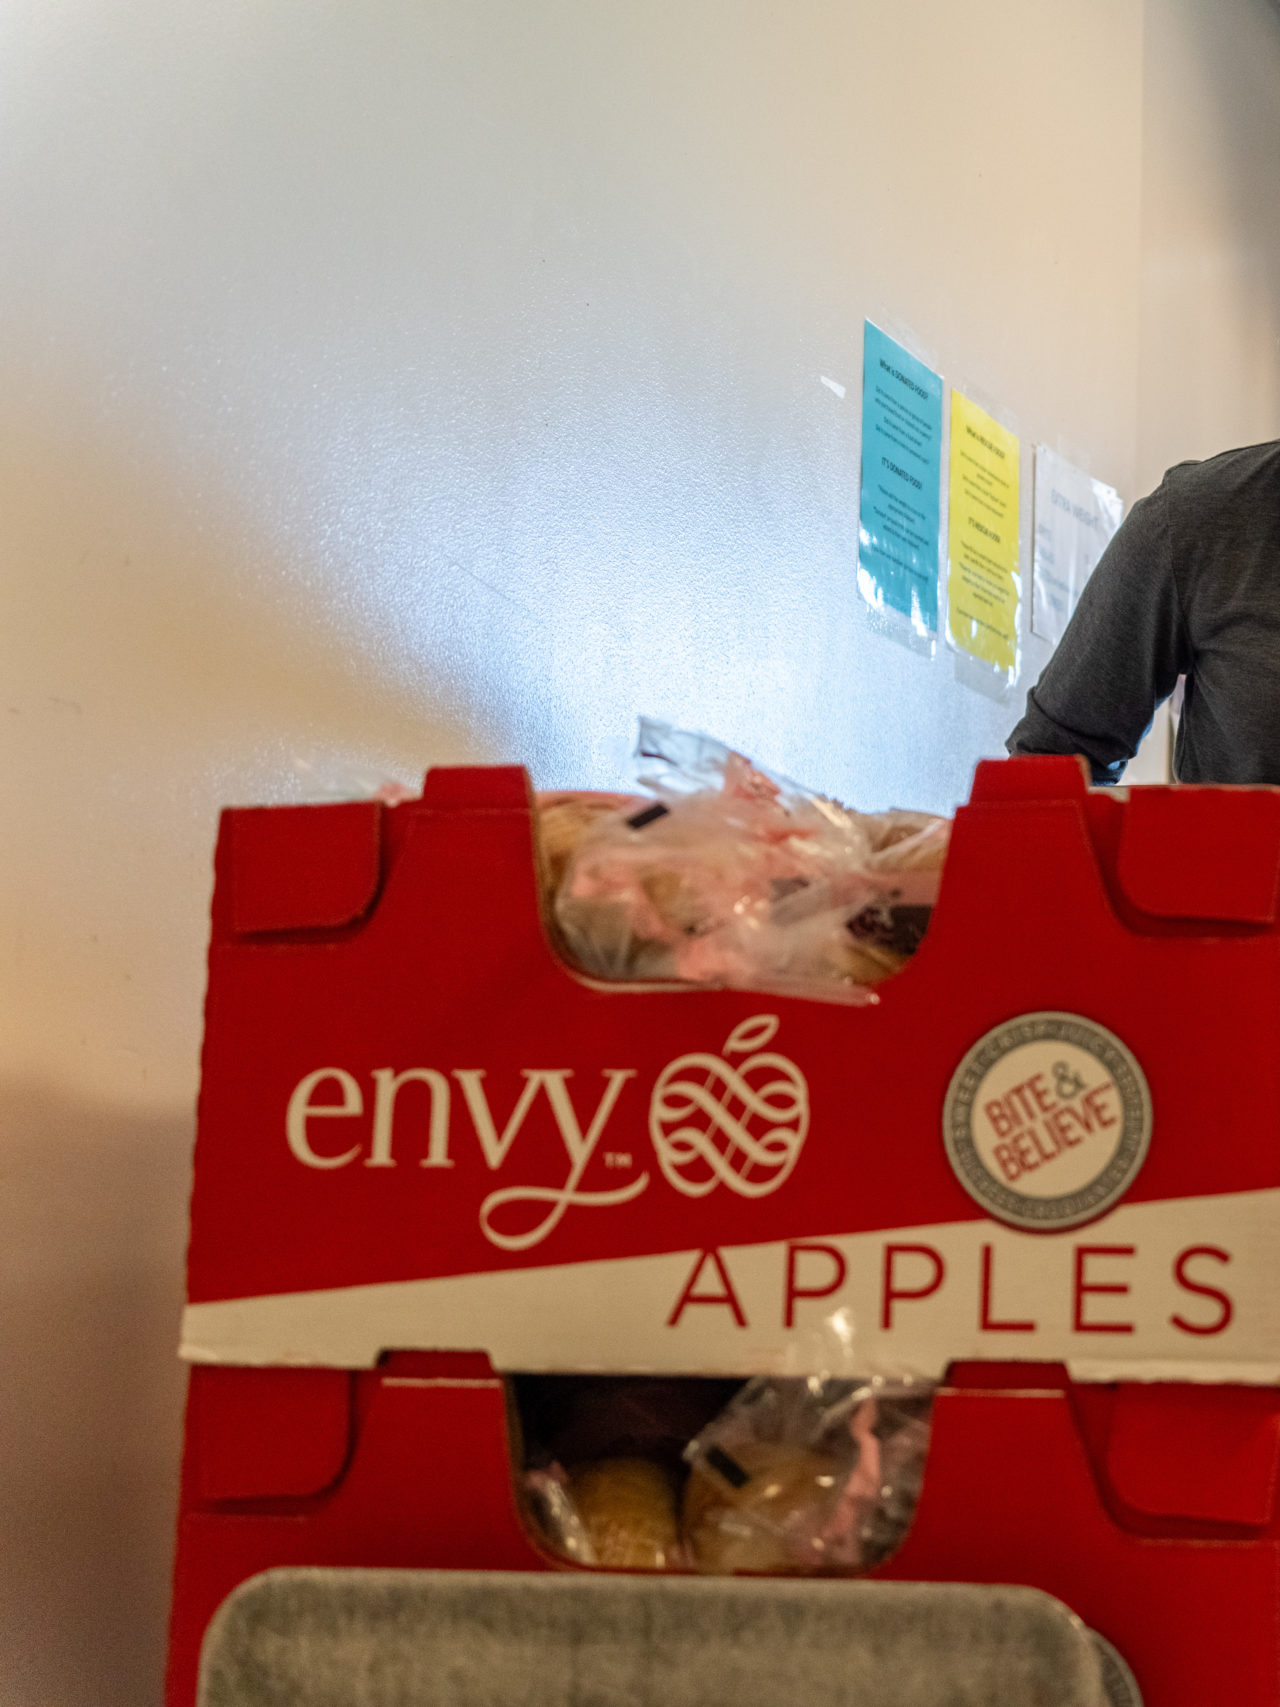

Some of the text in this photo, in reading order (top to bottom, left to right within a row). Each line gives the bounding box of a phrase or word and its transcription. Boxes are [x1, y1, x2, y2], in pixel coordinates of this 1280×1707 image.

[984, 1072, 1060, 1139] BITE
[1051, 1060, 1088, 1100] &
[993, 1077, 1118, 1183] BELIEVE
[285, 1065, 650, 1252] envy
[667, 1242, 1235, 1336] APPLES
